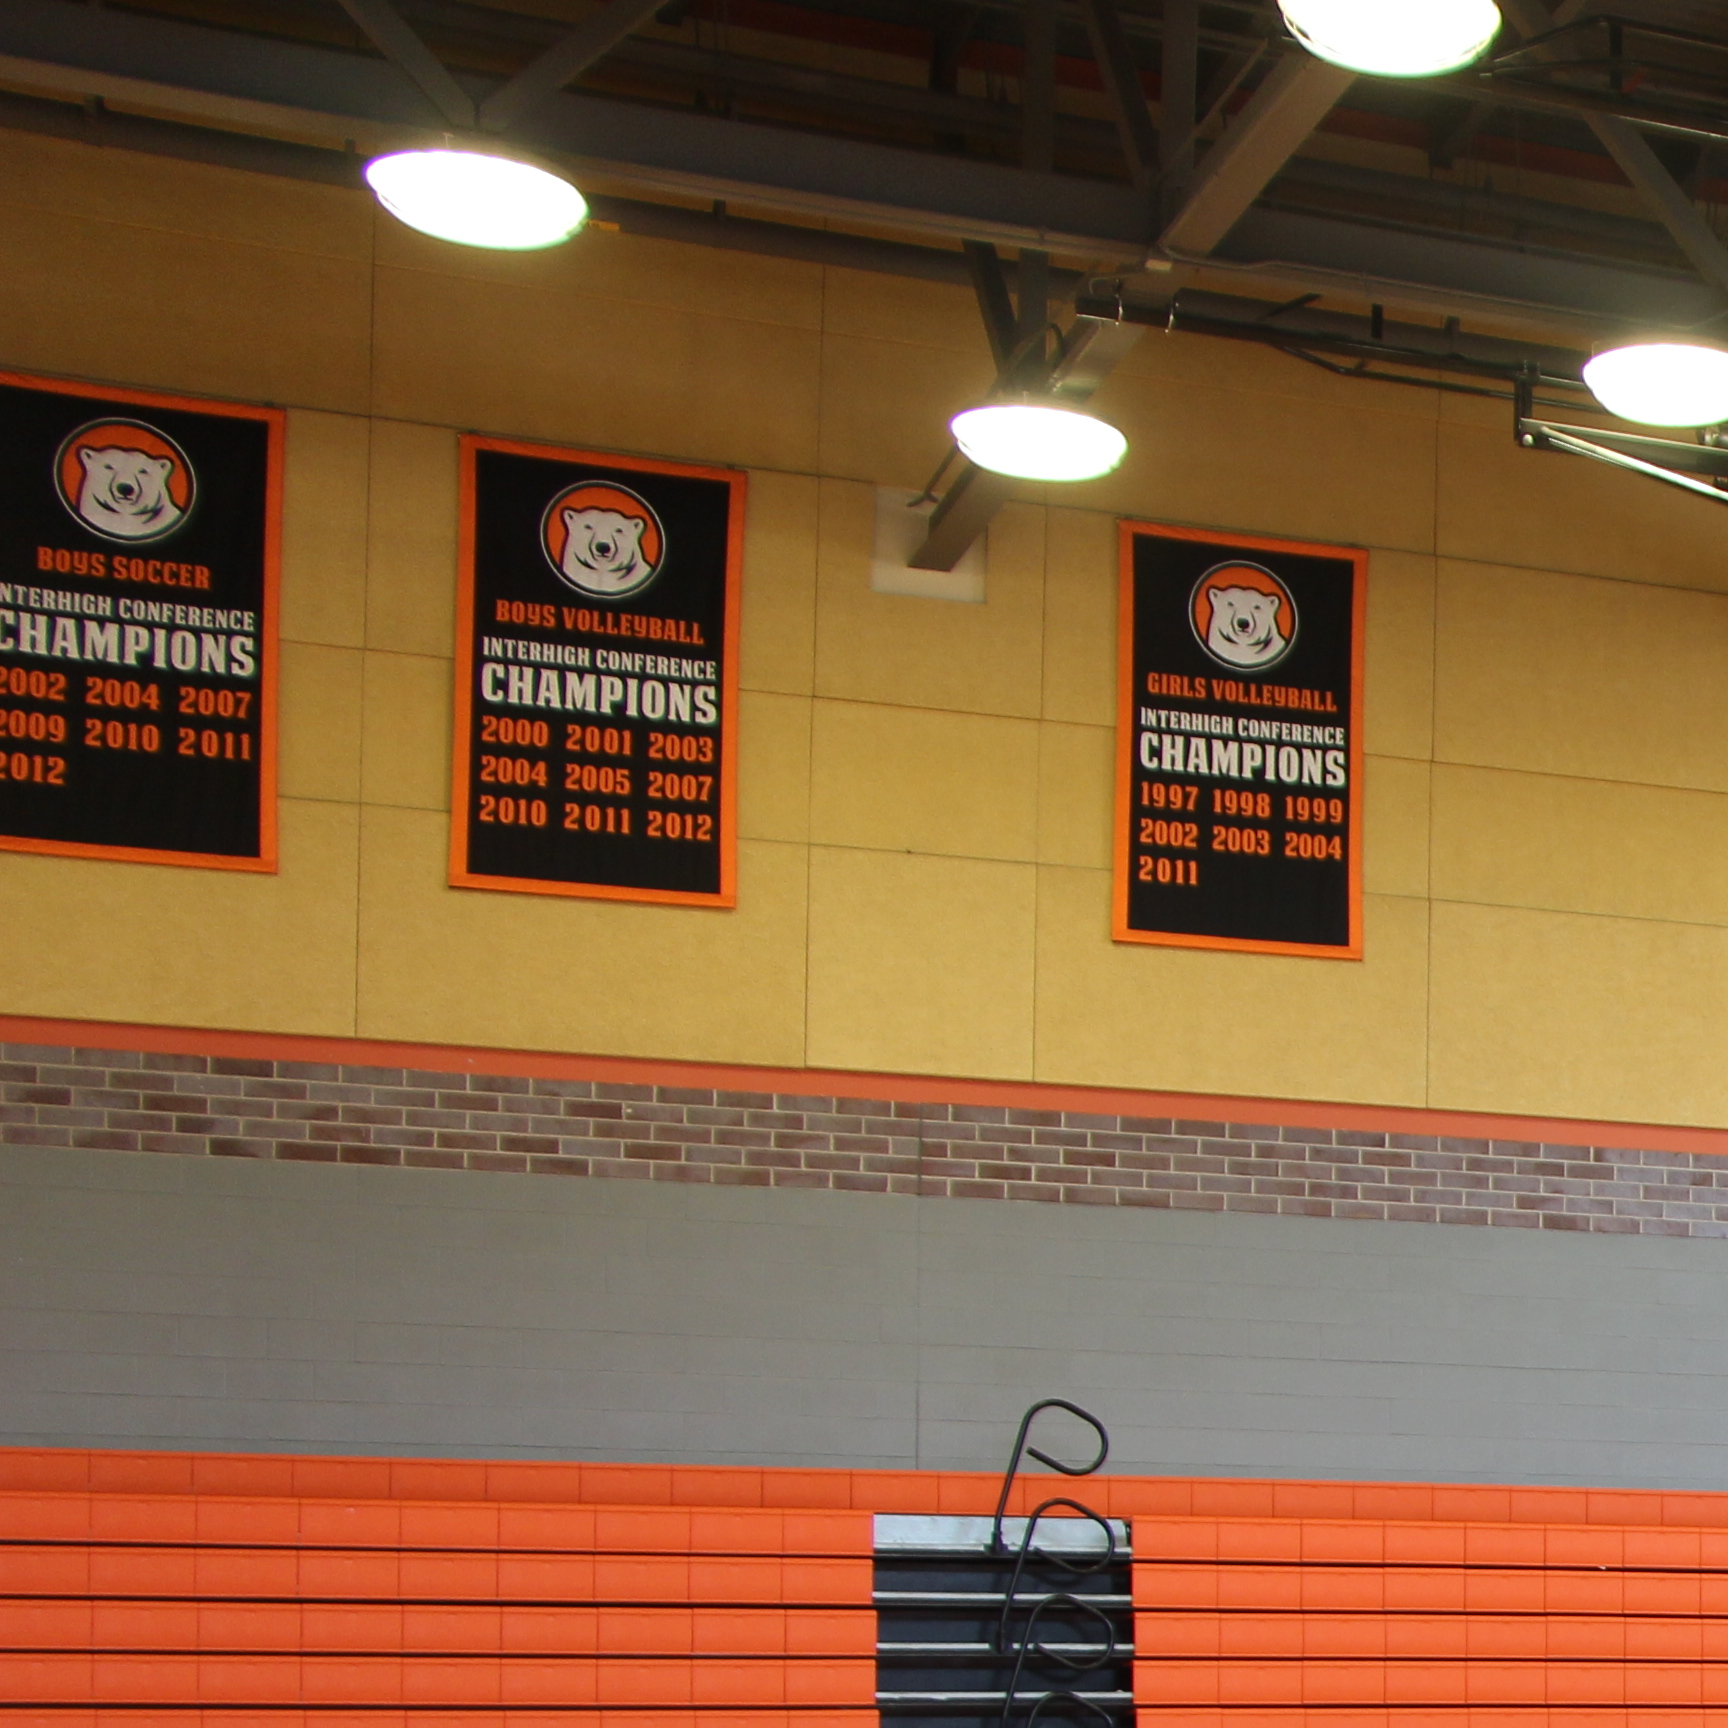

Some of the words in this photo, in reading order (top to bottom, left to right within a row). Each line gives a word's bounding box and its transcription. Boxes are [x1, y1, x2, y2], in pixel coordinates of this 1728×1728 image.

[37, 546, 107, 578] BOYS
[112, 555, 211, 589] SOCCER
[0, 582, 112, 617] NTERHIGH
[119, 598, 255, 631] CONFERENCE
[495, 599, 556, 627] BOYS
[562, 606, 704, 645] VOLLEYBALL
[482, 636, 590, 667] INTERHIGH
[596, 649, 716, 679] CONFERENCE
[85, 676, 160, 711] 2004
[178, 686, 252, 719] 2007
[481, 662, 717, 724] CHAMPIONS
[1147, 672, 1206, 698] GIRLS
[1211, 679, 1337, 712] VOLLEYBALL
[84, 718, 160, 753] 2010
[177, 727, 251, 760] 2011
[481, 715, 549, 747] 2000
[565, 724, 632, 756] 2001
[648, 732, 714, 763] 2003
[1140, 706, 1233, 736] INTERHIGH
[1237, 718, 1344, 745] CONFERENCE
[480, 755, 548, 787] 2004
[565, 763, 631, 795] 2005
[647, 771, 713, 801] 2007
[1140, 731, 1346, 786] CHAMPIONS
[479, 795, 547, 827] 2010
[563, 802, 631, 834] 2011
[647, 810, 713, 841] 2012
[1141, 781, 1199, 811] 1997
[1213, 788, 1271, 818] 1998
[1285, 796, 1343, 824] 1999
[1139, 818, 1198, 848] 2002
[1212, 825, 1270, 855] 2003
[1284, 832, 1342, 860] 2004
[1139, 855, 1198, 885] 2011
